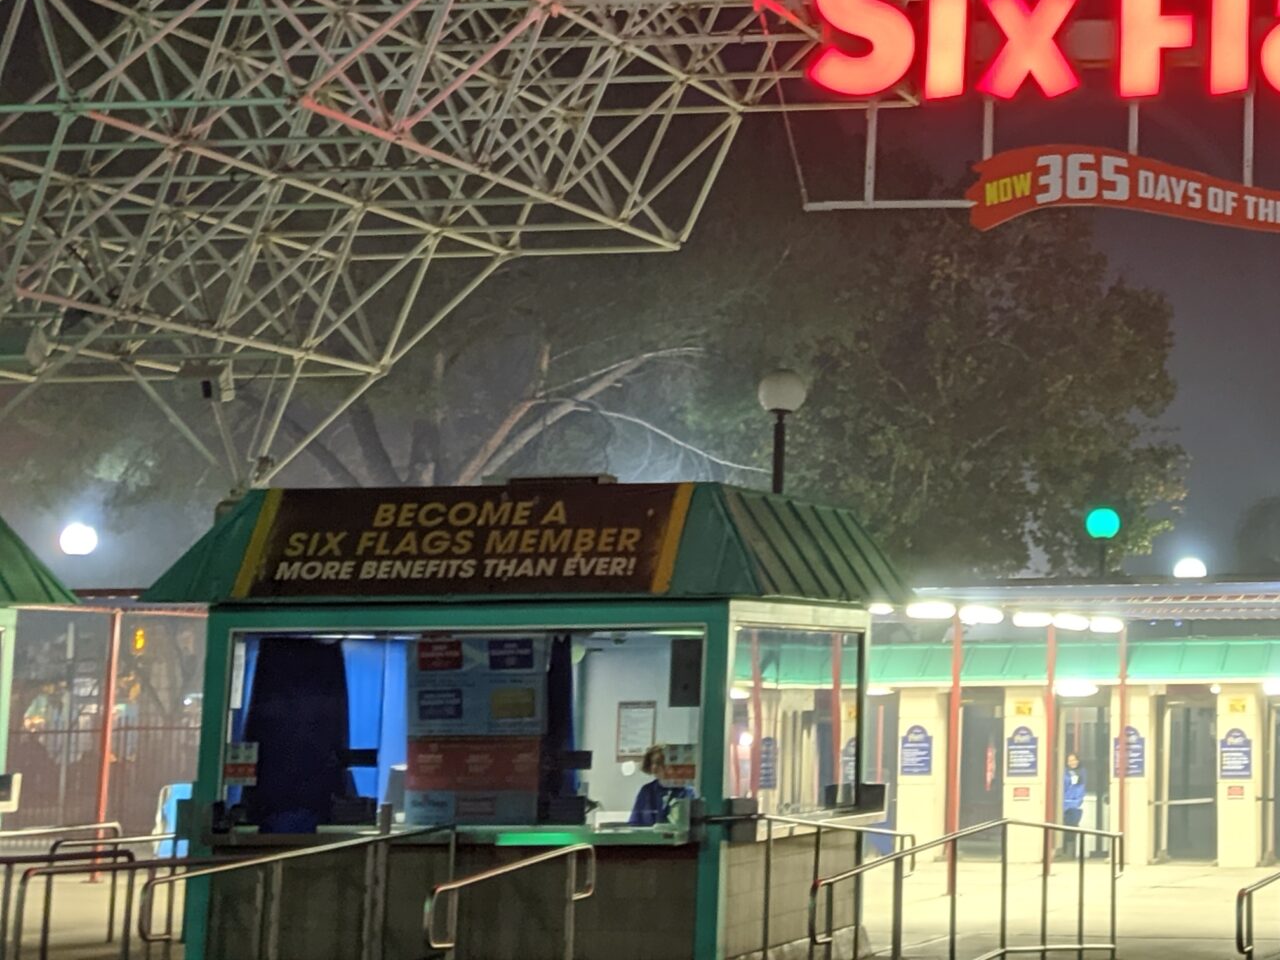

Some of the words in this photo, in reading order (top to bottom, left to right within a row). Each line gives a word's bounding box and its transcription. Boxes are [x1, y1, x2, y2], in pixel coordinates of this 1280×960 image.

[985, 171, 1032, 206] NOW
[1035, 153, 1130, 204] 365
[1138, 170, 1202, 208] DAYS
[1207, 187, 1238, 215] OF
[372, 501, 534, 528] BECOME
[540, 500, 567, 526] A
[284, 531, 347, 557] SIX
[355, 530, 473, 556] FLAGS
[484, 528, 641, 554] MEMBER
[274, 560, 354, 581] MORE
[359, 559, 476, 580] BENEFITS
[483, 558, 560, 579] THAN
[564, 557, 636, 576] EVER!
